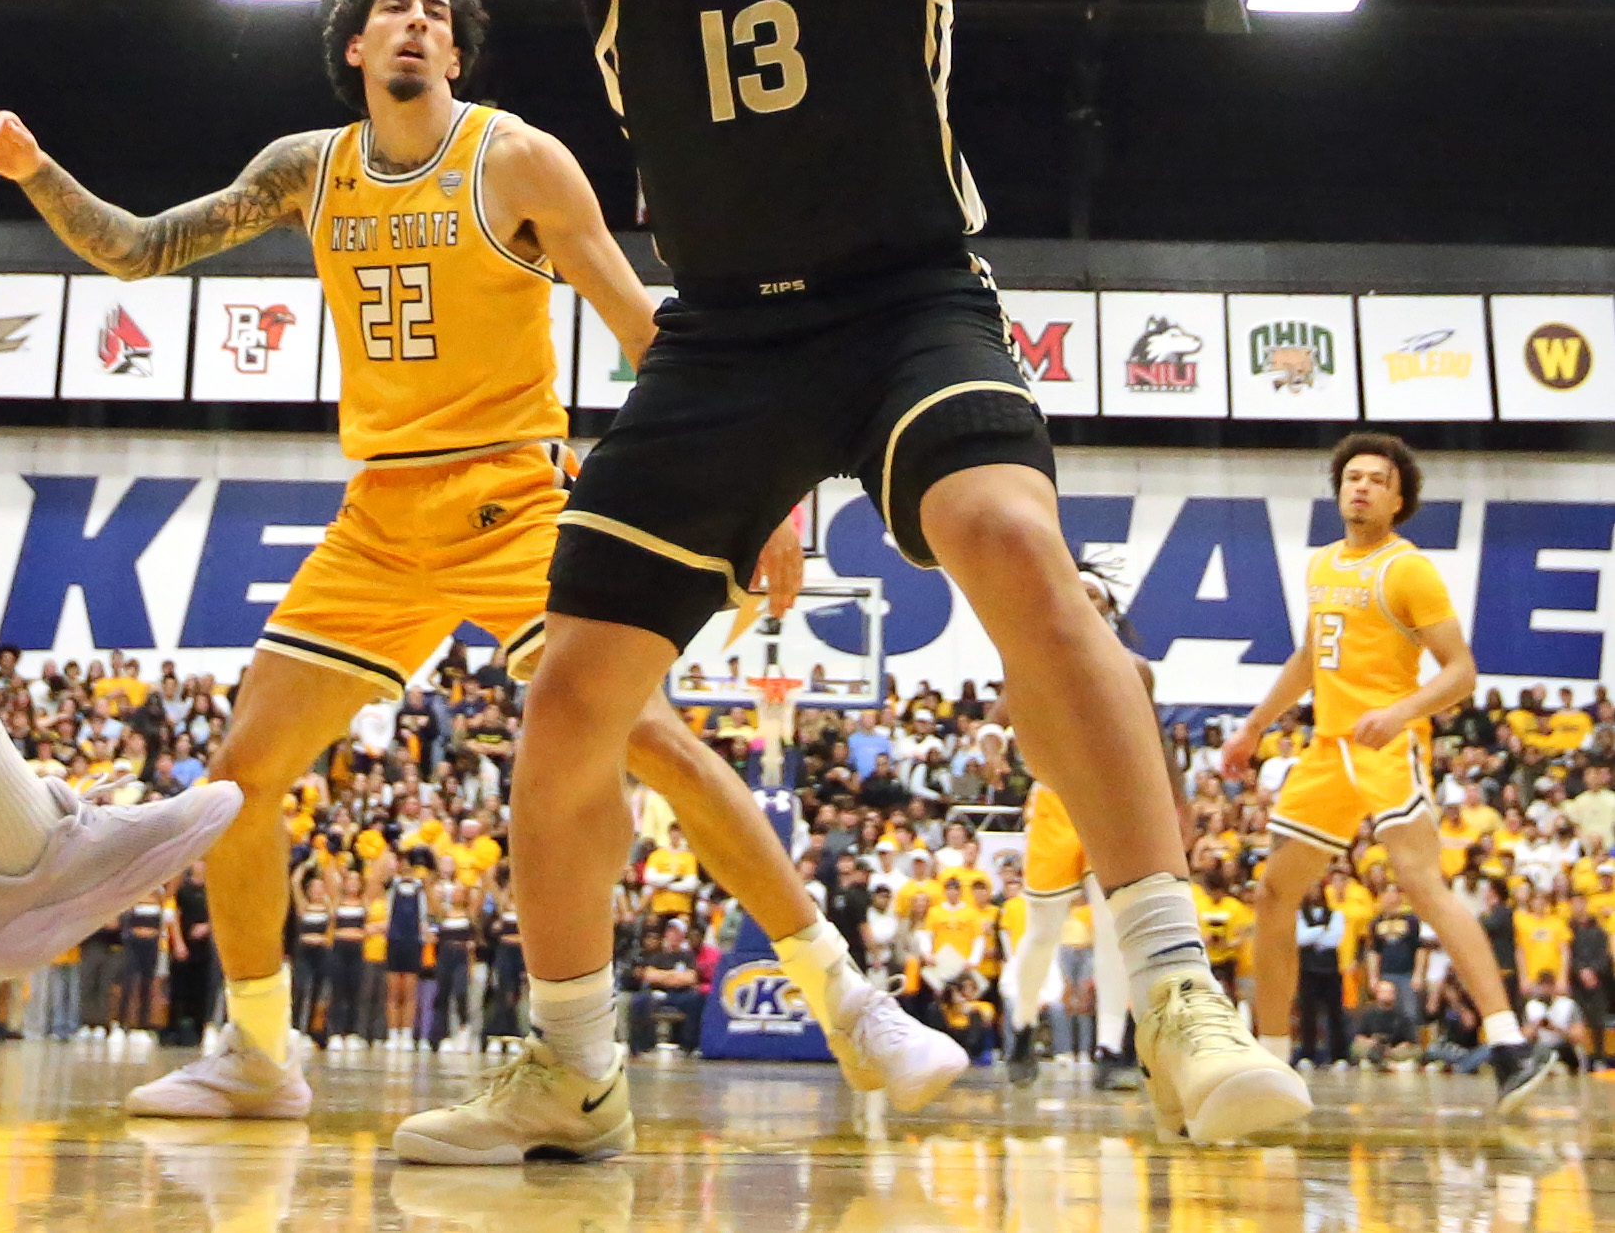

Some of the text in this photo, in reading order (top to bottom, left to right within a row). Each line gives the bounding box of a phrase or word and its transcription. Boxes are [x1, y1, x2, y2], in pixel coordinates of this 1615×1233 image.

[700, 0, 808, 122] 13
[331, 211, 459, 252] KENT STATE
[759, 279, 806, 295] ZIPS
[354, 263, 437, 361] 22
[1250, 320, 1335, 375] OHIO
[1383, 351, 1473, 384] TOLEDO
[1532, 337, 1580, 380] W
[1126, 362, 1197, 386] NIU
